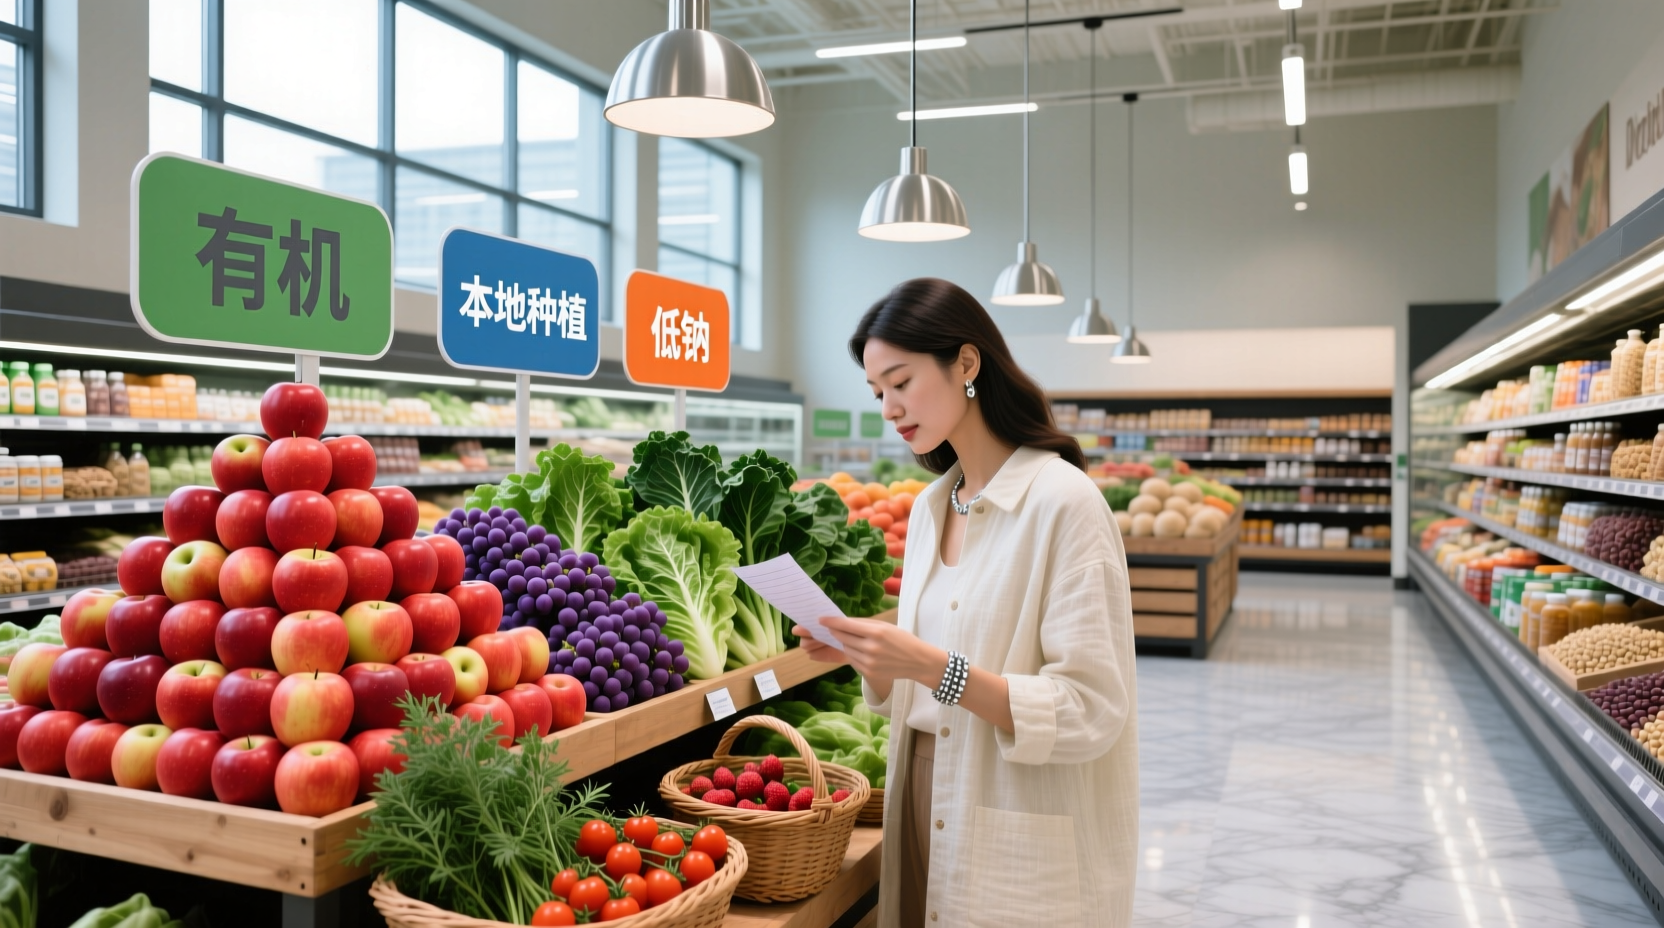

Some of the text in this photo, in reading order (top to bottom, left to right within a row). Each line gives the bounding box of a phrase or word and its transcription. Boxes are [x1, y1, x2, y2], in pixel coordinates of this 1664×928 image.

[195, 206, 350, 321] 有机
[459, 274, 587, 341] 本地种植
[651, 305, 710, 363] 低钠
